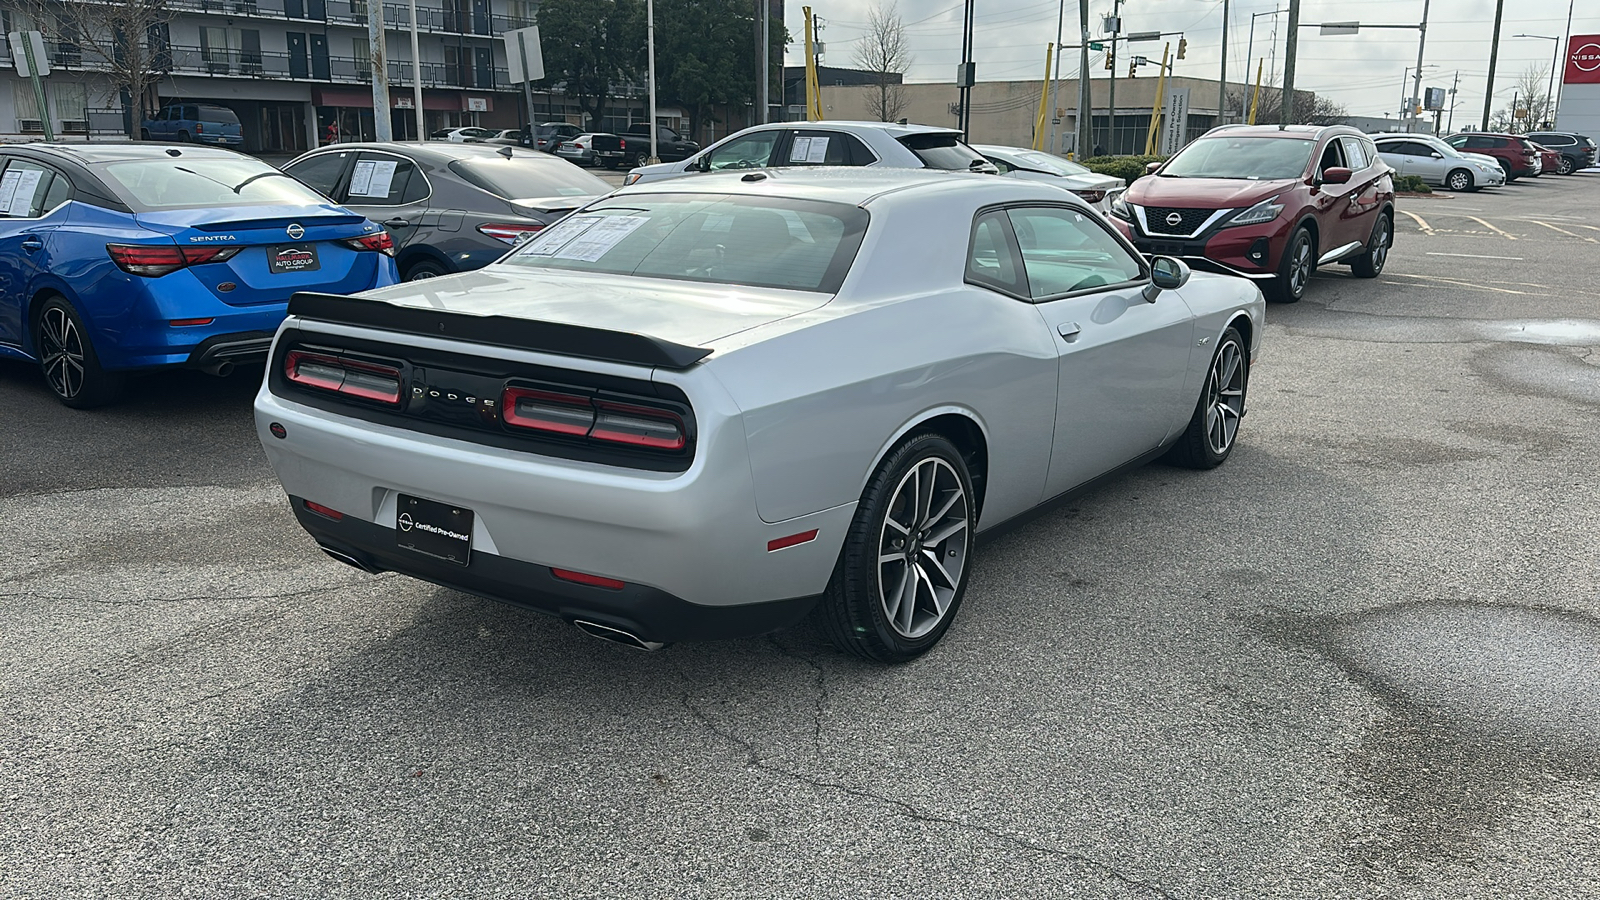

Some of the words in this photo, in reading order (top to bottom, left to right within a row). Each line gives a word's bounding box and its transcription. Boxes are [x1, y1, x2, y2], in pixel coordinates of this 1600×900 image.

[413, 387, 494, 407] DODGE
[415, 522, 437, 533] Certified
[438, 528, 469, 541] Pre-Owned
